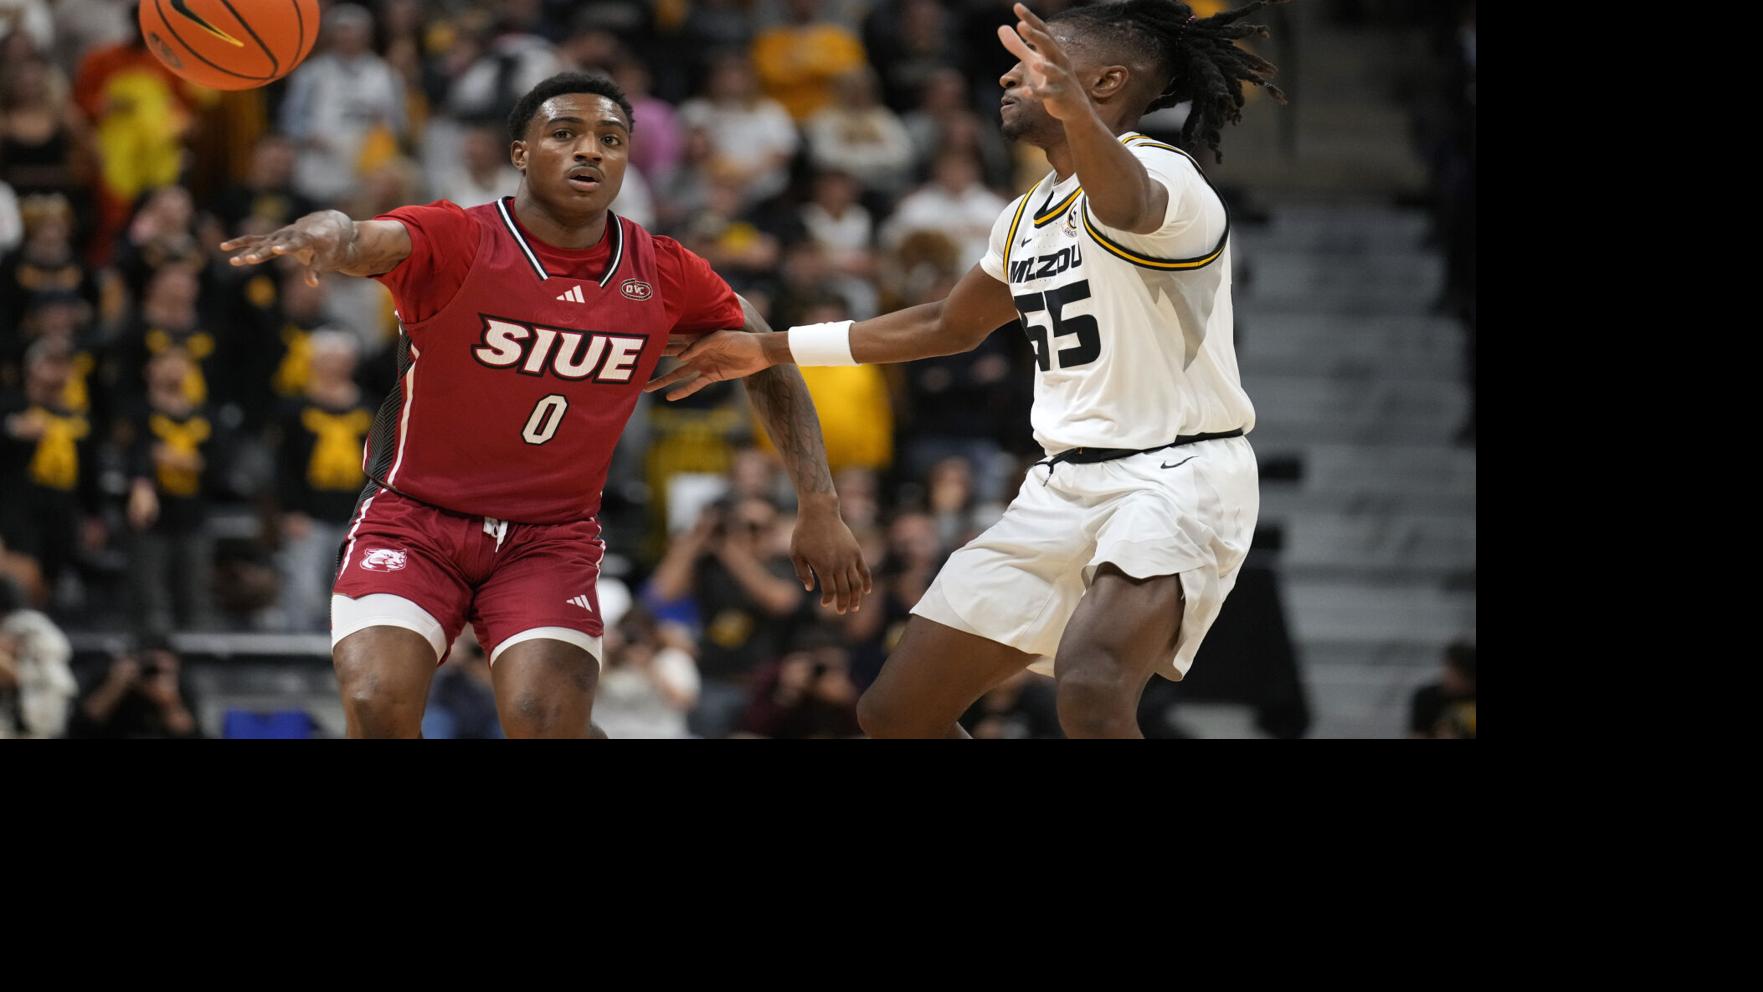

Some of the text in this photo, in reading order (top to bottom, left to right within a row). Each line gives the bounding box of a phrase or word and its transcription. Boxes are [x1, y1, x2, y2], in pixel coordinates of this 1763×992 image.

[1010, 241, 1082, 283] MIZOU
[471, 313, 649, 384] SIUE
[1014, 279, 1101, 371] 55
[522, 394, 569, 445] 0
